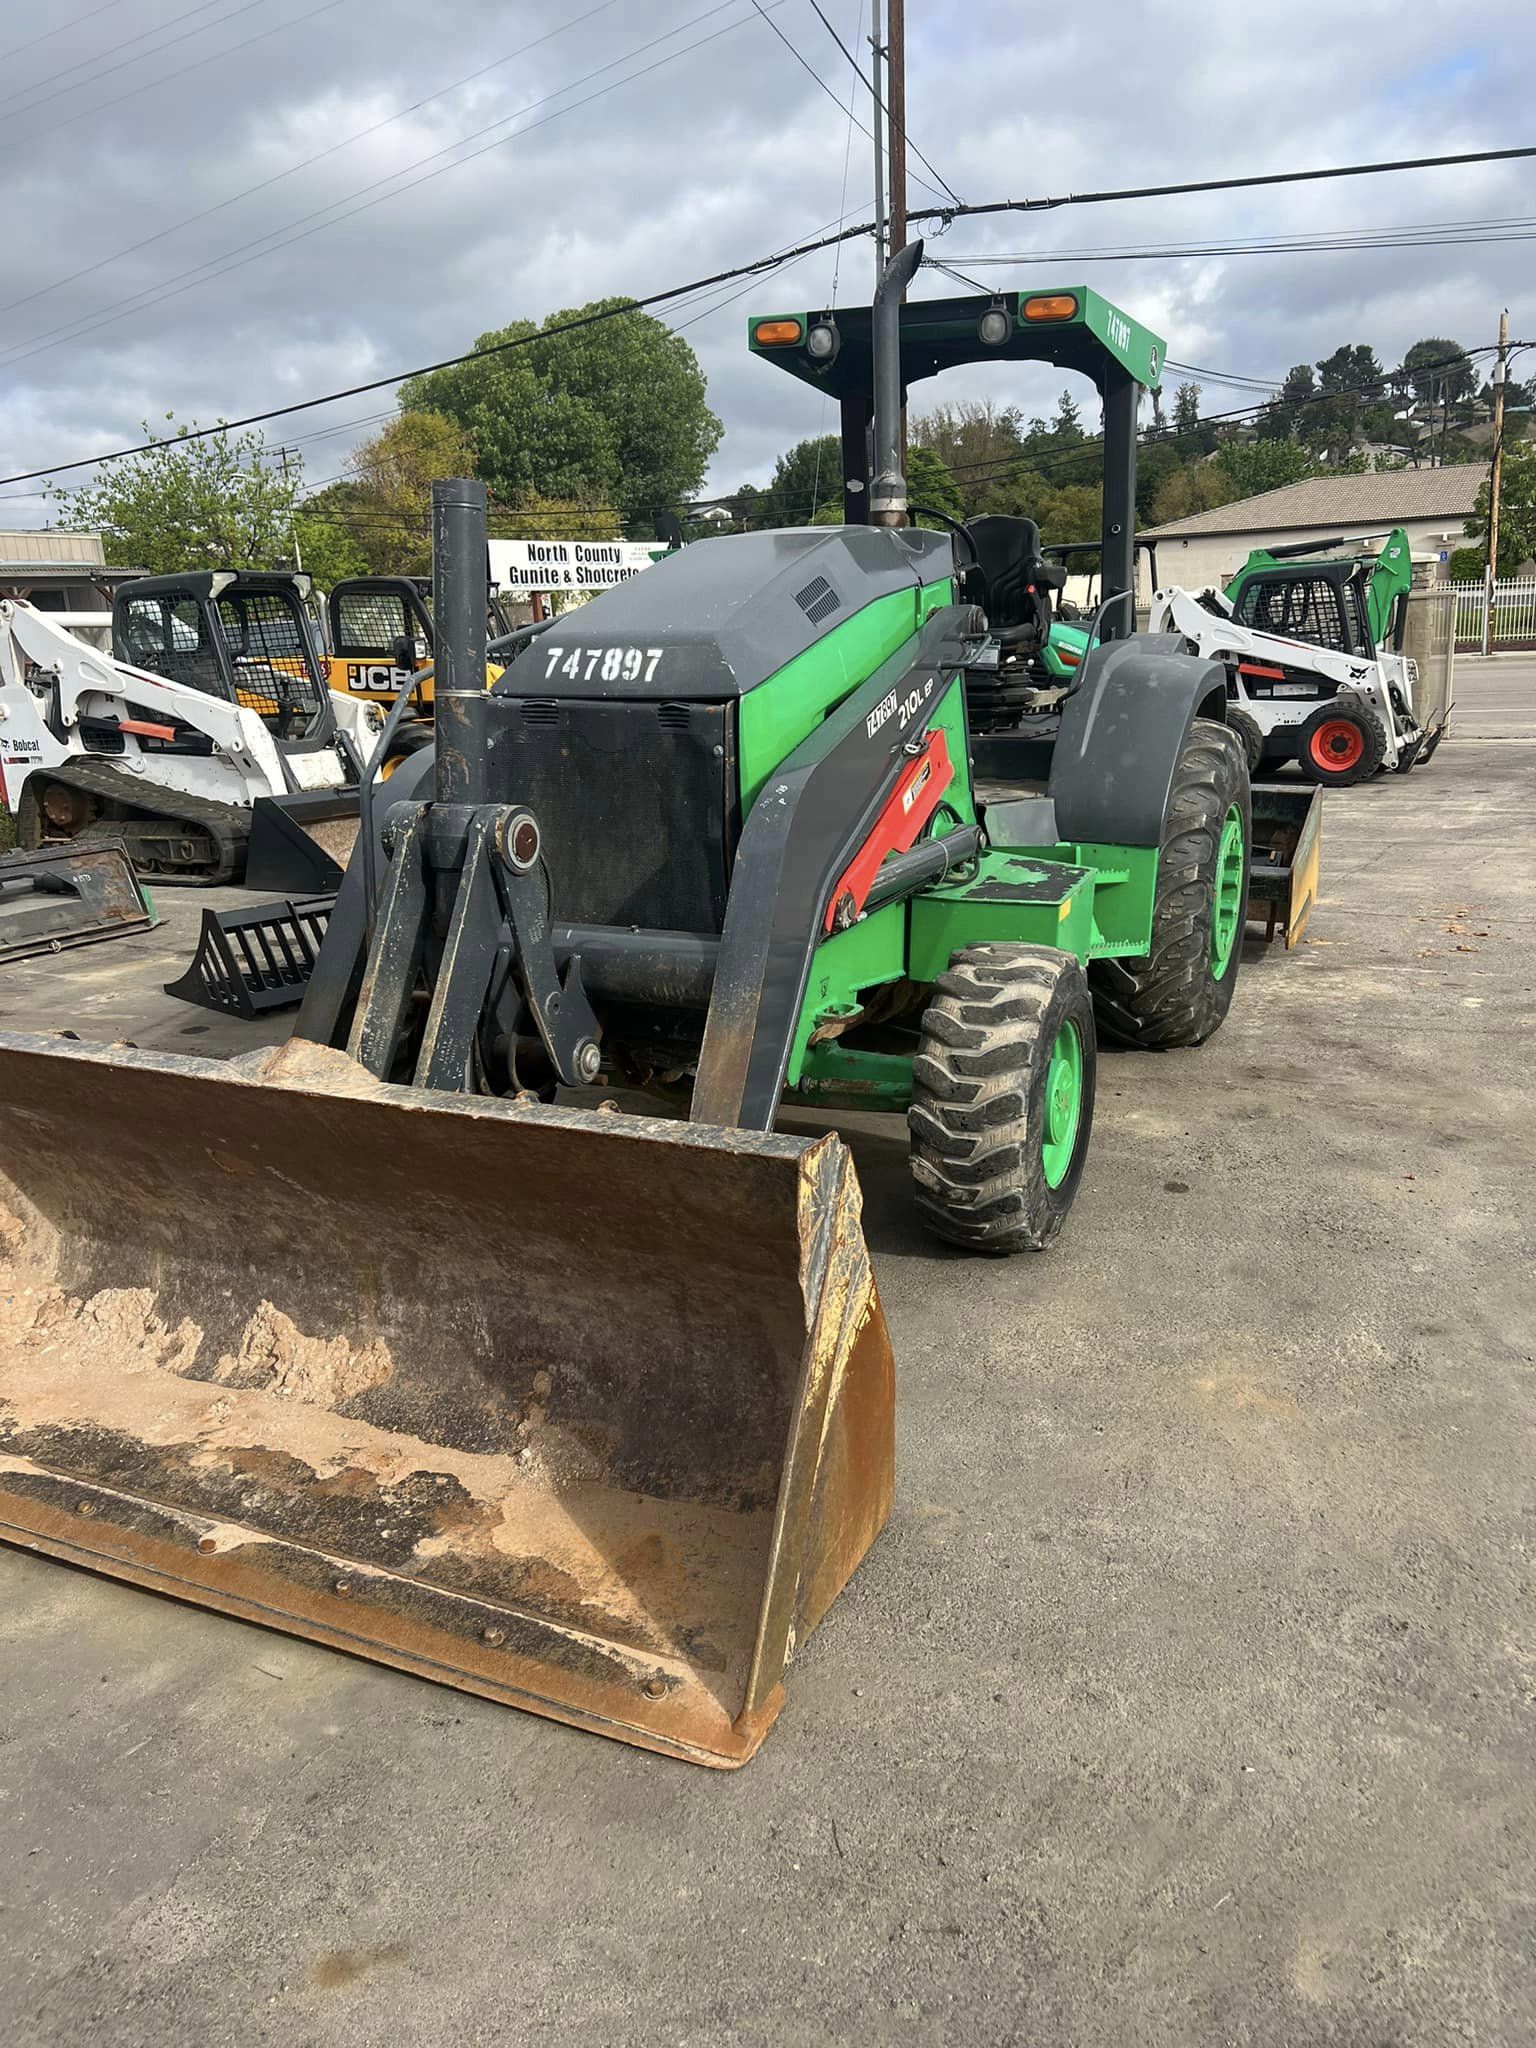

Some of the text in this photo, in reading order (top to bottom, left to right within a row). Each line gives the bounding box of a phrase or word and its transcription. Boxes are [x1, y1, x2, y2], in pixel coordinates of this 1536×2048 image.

[1107, 309, 1131, 352] 747897
[527, 543, 568, 562] North
[575, 545, 621, 564] County
[509, 566, 559, 584] Gunite
[563, 570, 572, 583] &
[349, 665, 412, 691] JCB
[545, 648, 664, 682] 747897
[867, 690, 897, 737] 747897
[898, 677, 934, 730] 210L EP
[12, 739, 40, 752] Bobcat
